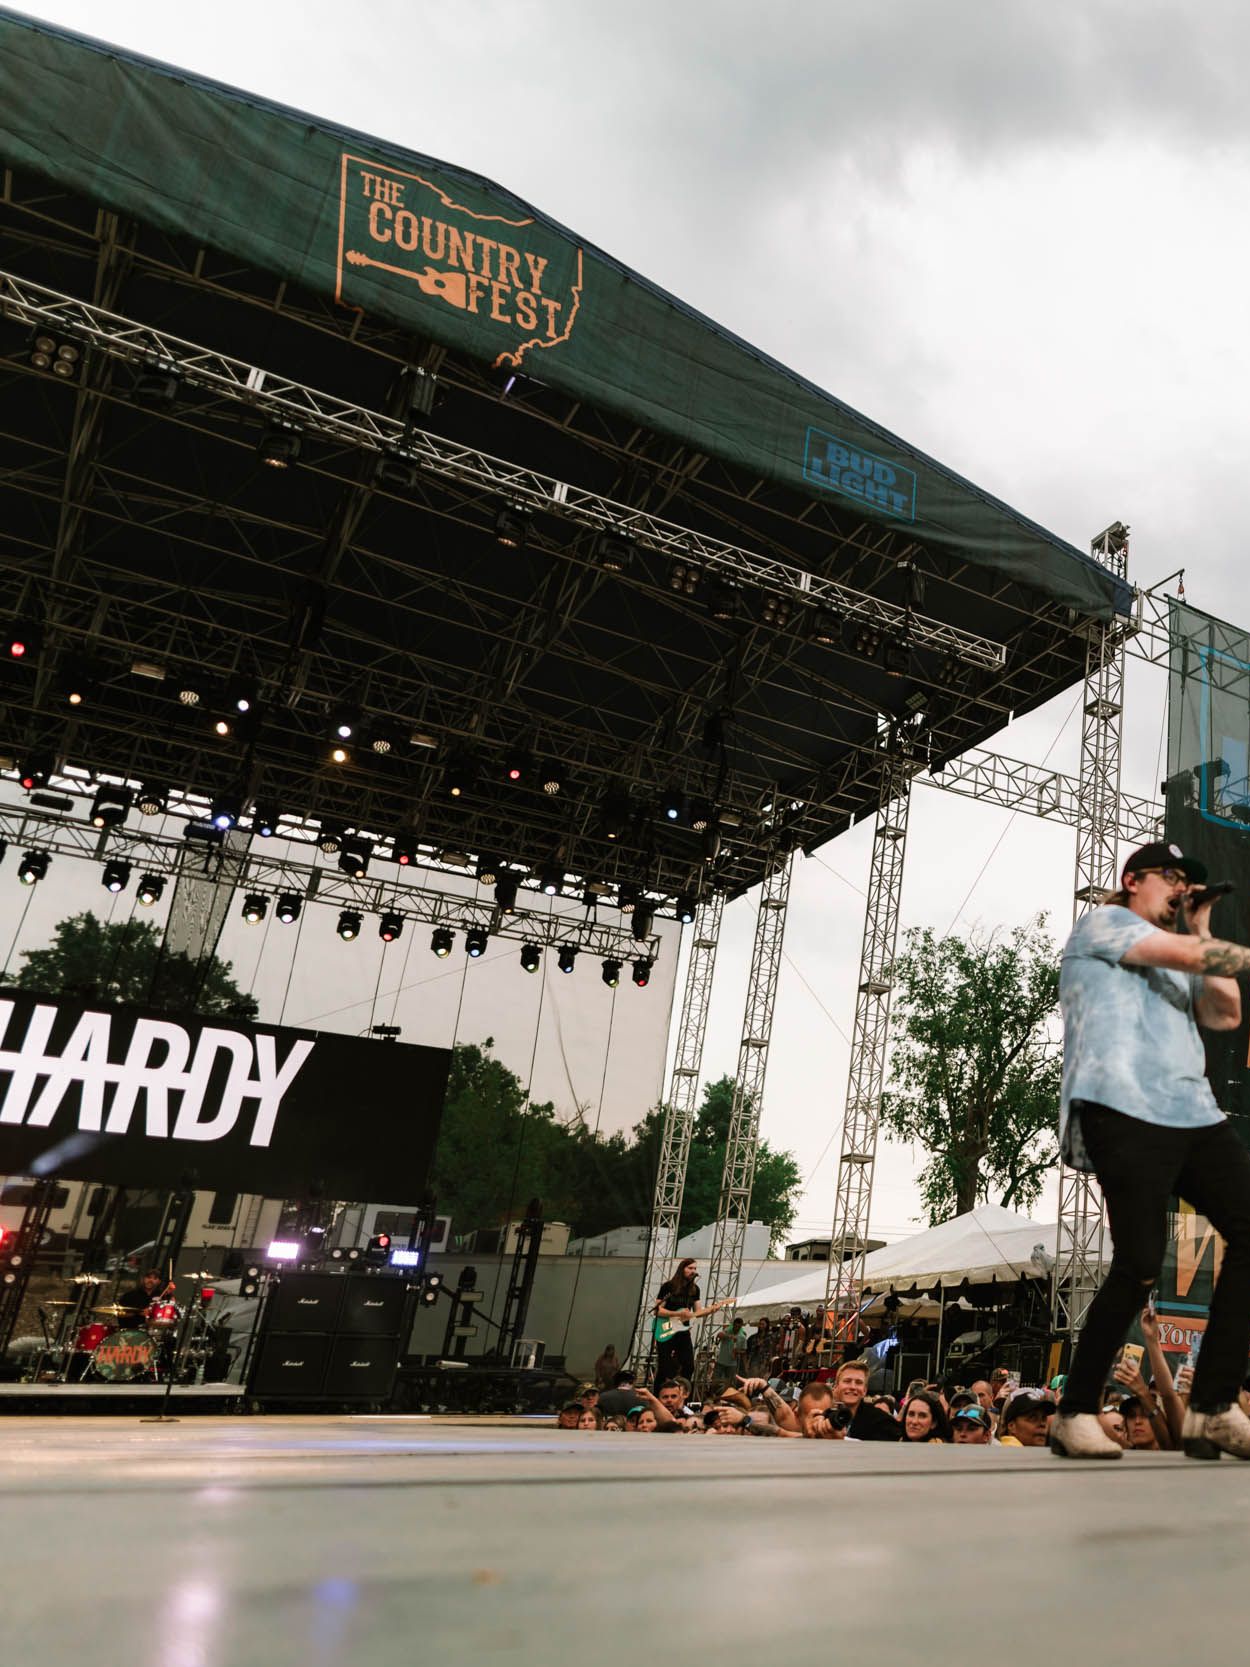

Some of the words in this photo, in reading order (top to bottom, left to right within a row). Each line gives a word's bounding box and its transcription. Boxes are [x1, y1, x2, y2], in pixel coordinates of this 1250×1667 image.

[360, 171, 405, 208] THE
[368, 201, 548, 295] COUNTRY
[467, 272, 561, 338] FEST
[810, 457, 909, 513] LIGHT
[827, 441, 897, 487] BUD
[0, 1000, 316, 1147] HARDY
[1158, 1323, 1204, 1345] You
